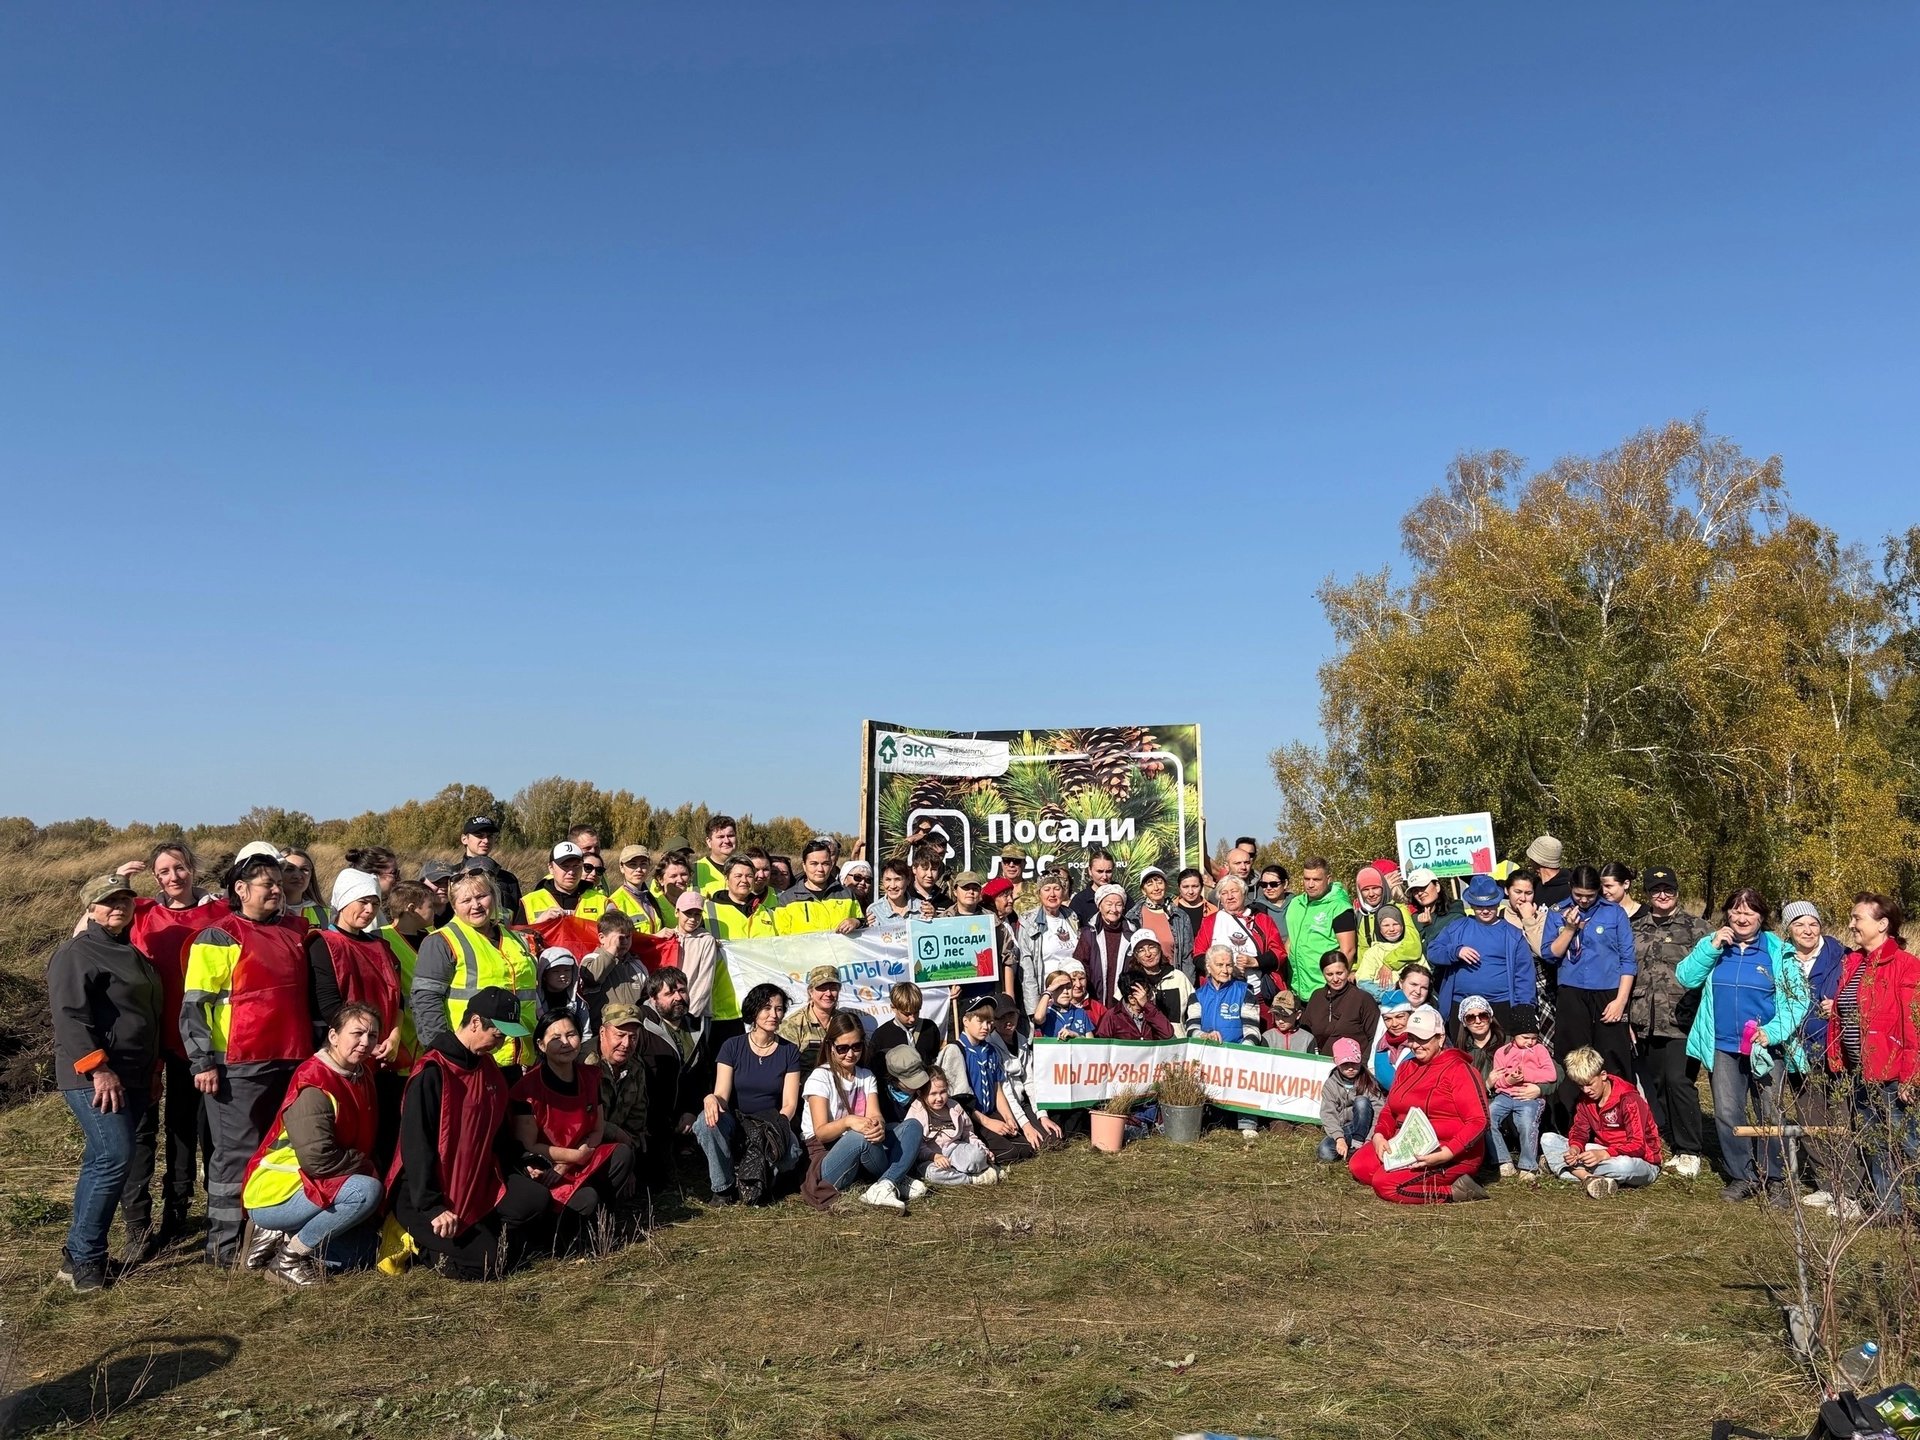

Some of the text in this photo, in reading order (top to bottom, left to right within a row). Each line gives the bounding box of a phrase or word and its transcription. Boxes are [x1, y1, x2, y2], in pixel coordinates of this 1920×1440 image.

[902, 743, 936, 759] ЭКА
[987, 813, 1135, 848] Посади
[1435, 835, 1482, 846] Посади
[1436, 847, 1458, 857] лес
[943, 934, 986, 946] Посади
[944, 947, 965, 957] лес
[1054, 1063, 1082, 1085] МЫ
[1084, 1063, 1149, 1086] ДРУЗЬЯ
[1237, 1068, 1322, 1102] БАШКИРИ
